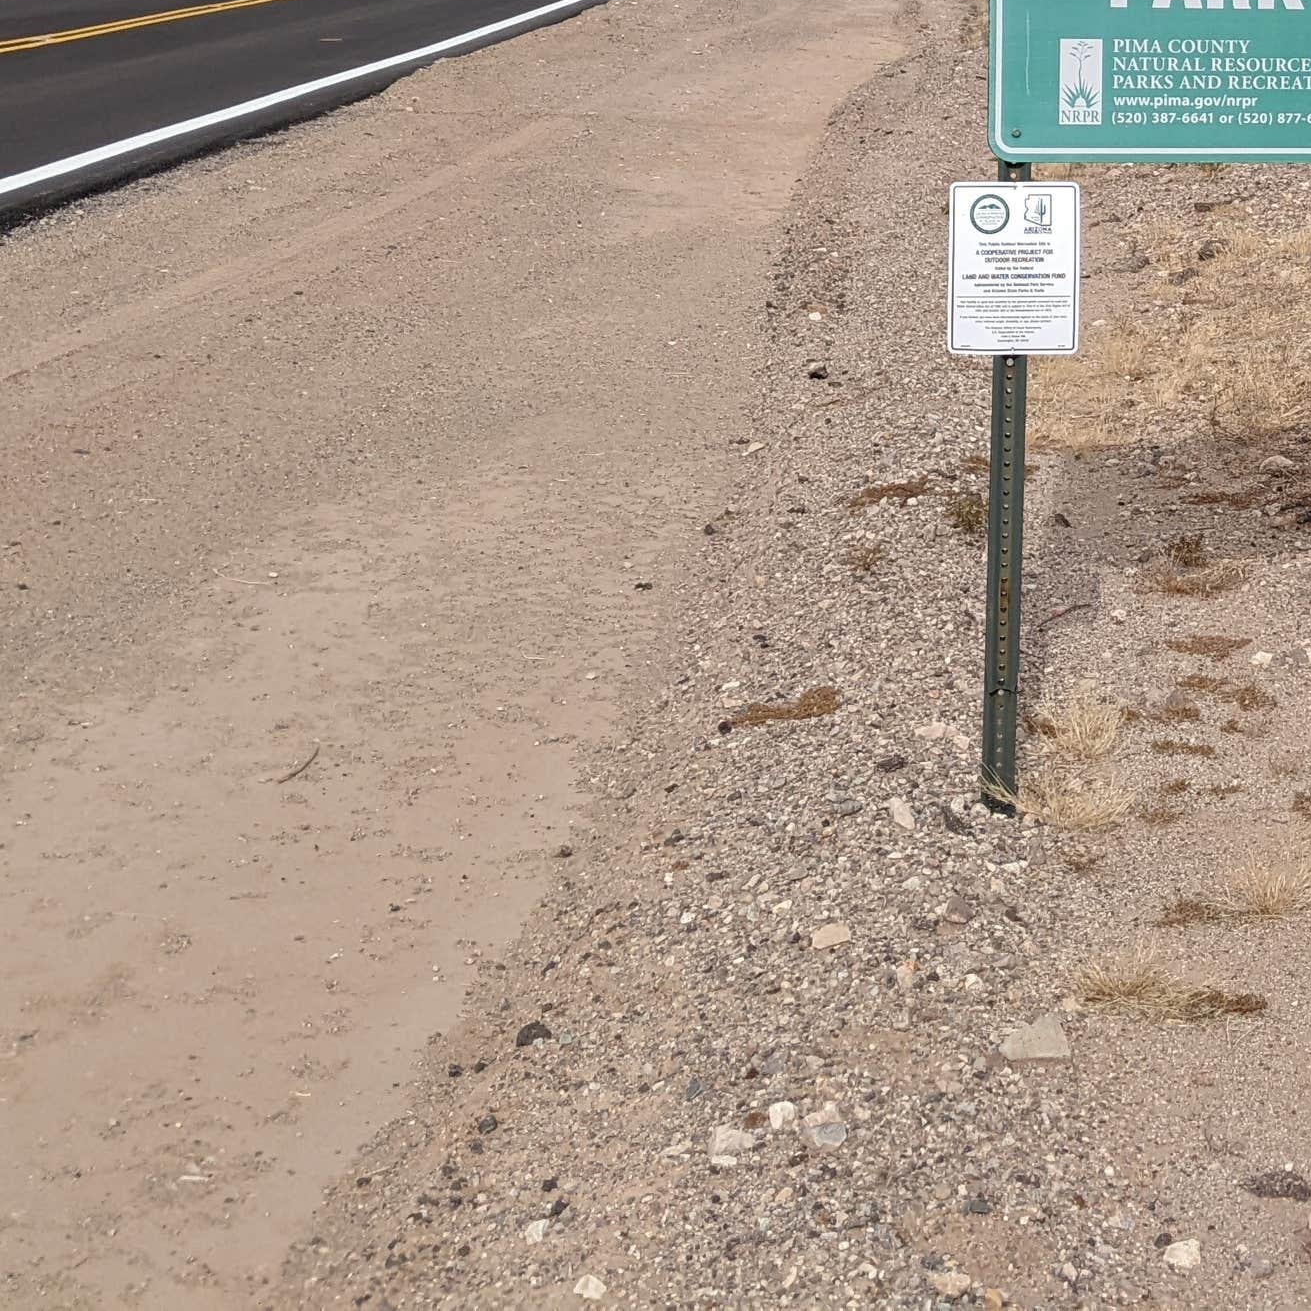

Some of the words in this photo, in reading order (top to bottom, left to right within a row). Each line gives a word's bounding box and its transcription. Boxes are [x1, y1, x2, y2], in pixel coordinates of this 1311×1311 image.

[1113, 38, 1162, 53] PIMA
[1167, 39, 1250, 54] COUNTY
[1113, 56, 1205, 71] NATURAL
[1112, 74, 1173, 89] PARKS
[1179, 75, 1222, 89] AND
[1113, 93, 1258, 109] www.pima.gov/nrpr
[1061, 110, 1100, 123] NRPR
[1111, 111, 1147, 125] (520)
[1151, 112, 1213, 124] 387-6641
[1218, 114, 1234, 124] or
[1237, 112, 1273, 125] (520)
